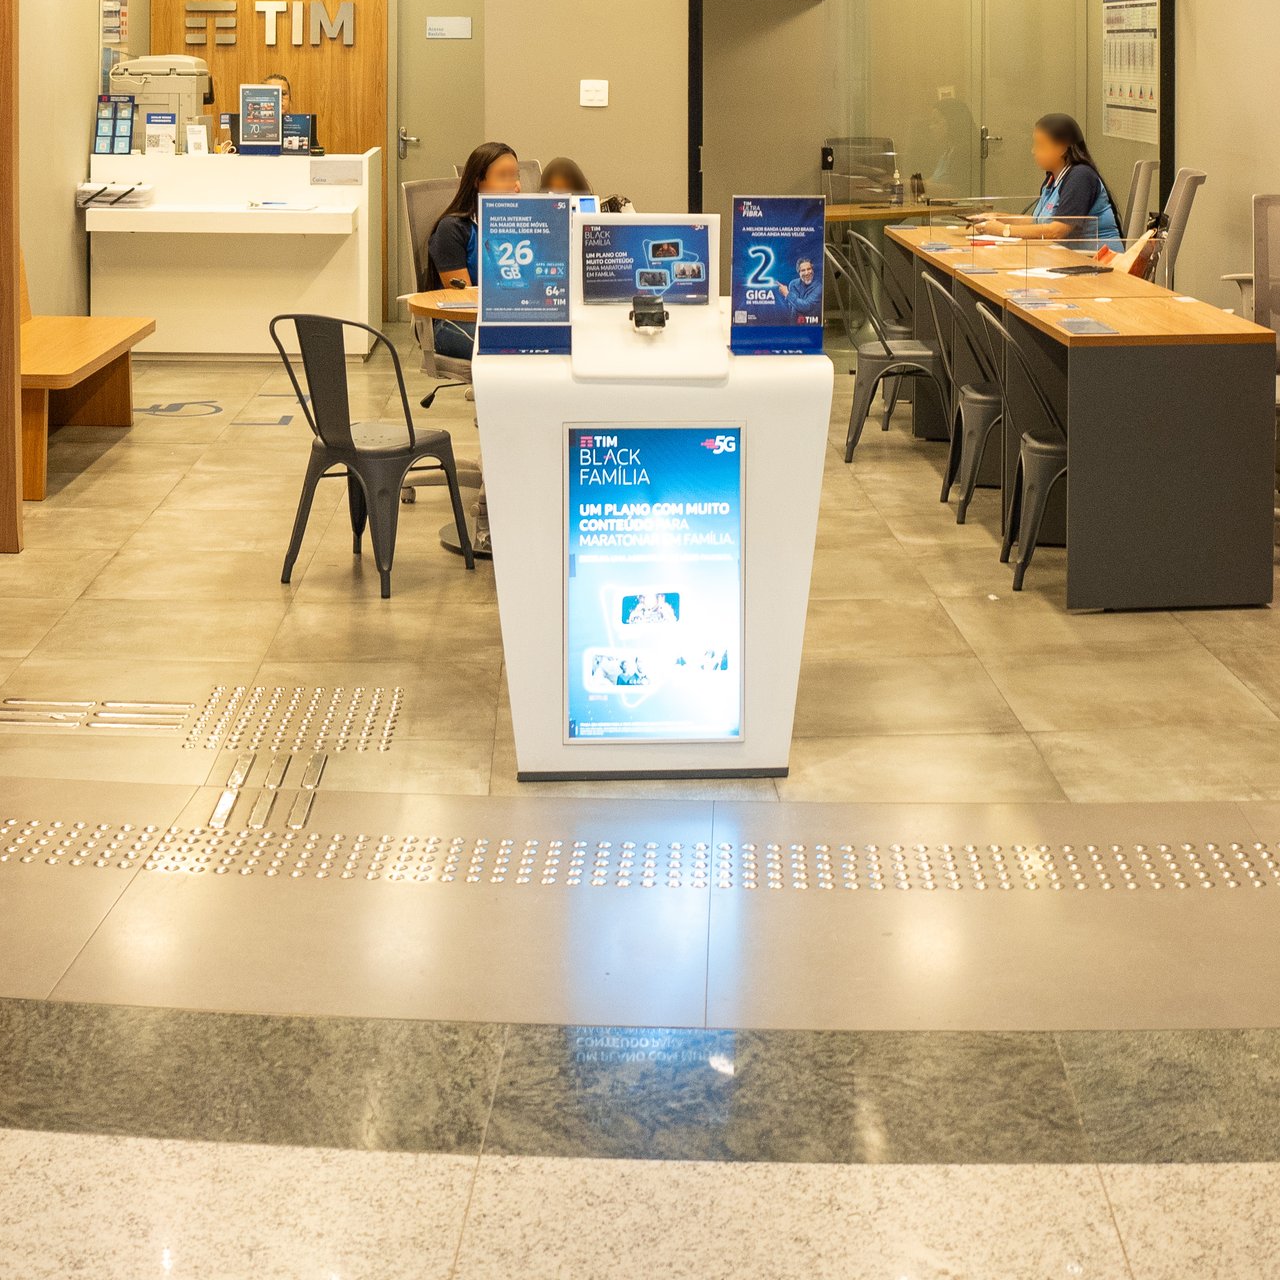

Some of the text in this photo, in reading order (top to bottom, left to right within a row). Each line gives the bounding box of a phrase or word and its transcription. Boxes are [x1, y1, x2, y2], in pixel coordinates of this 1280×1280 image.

[254, 1, 356, 46] TIM
[584, 231, 611, 239] BLACK
[498, 239, 534, 266] 26
[500, 266, 522, 280] GB
[747, 245, 775, 287] 2
[553, 298, 566, 306] TIM
[746, 290, 775, 300] GIGA
[805, 315, 819, 324] TIM
[594, 435, 618, 448] TIM
[713, 435, 736, 454] 5G
[579, 448, 641, 466] BLACK
[579, 465, 651, 486] FAMÍLIA
[579, 502, 730, 516] UM PLANO COM MUITO
[579, 514, 654, 532] CONTEÚDO
[684, 527, 735, 546] FAMÍLIA.
